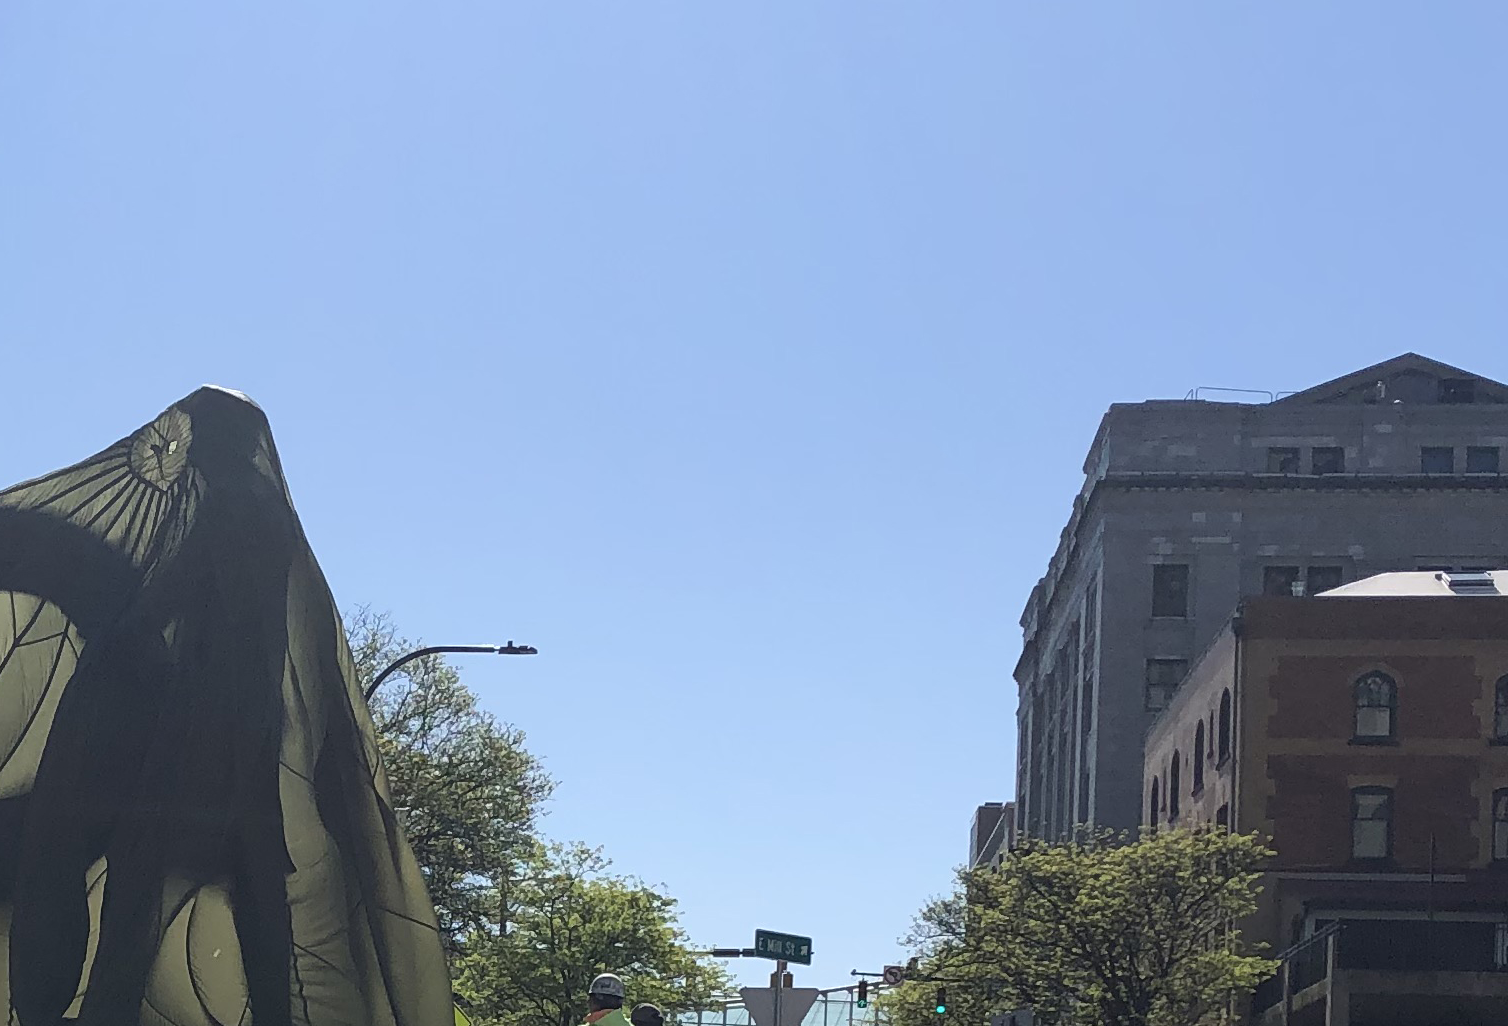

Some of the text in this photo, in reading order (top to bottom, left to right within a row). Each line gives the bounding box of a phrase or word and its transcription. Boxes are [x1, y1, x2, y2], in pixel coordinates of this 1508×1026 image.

[758, 937, 795, 956] E Mill St
